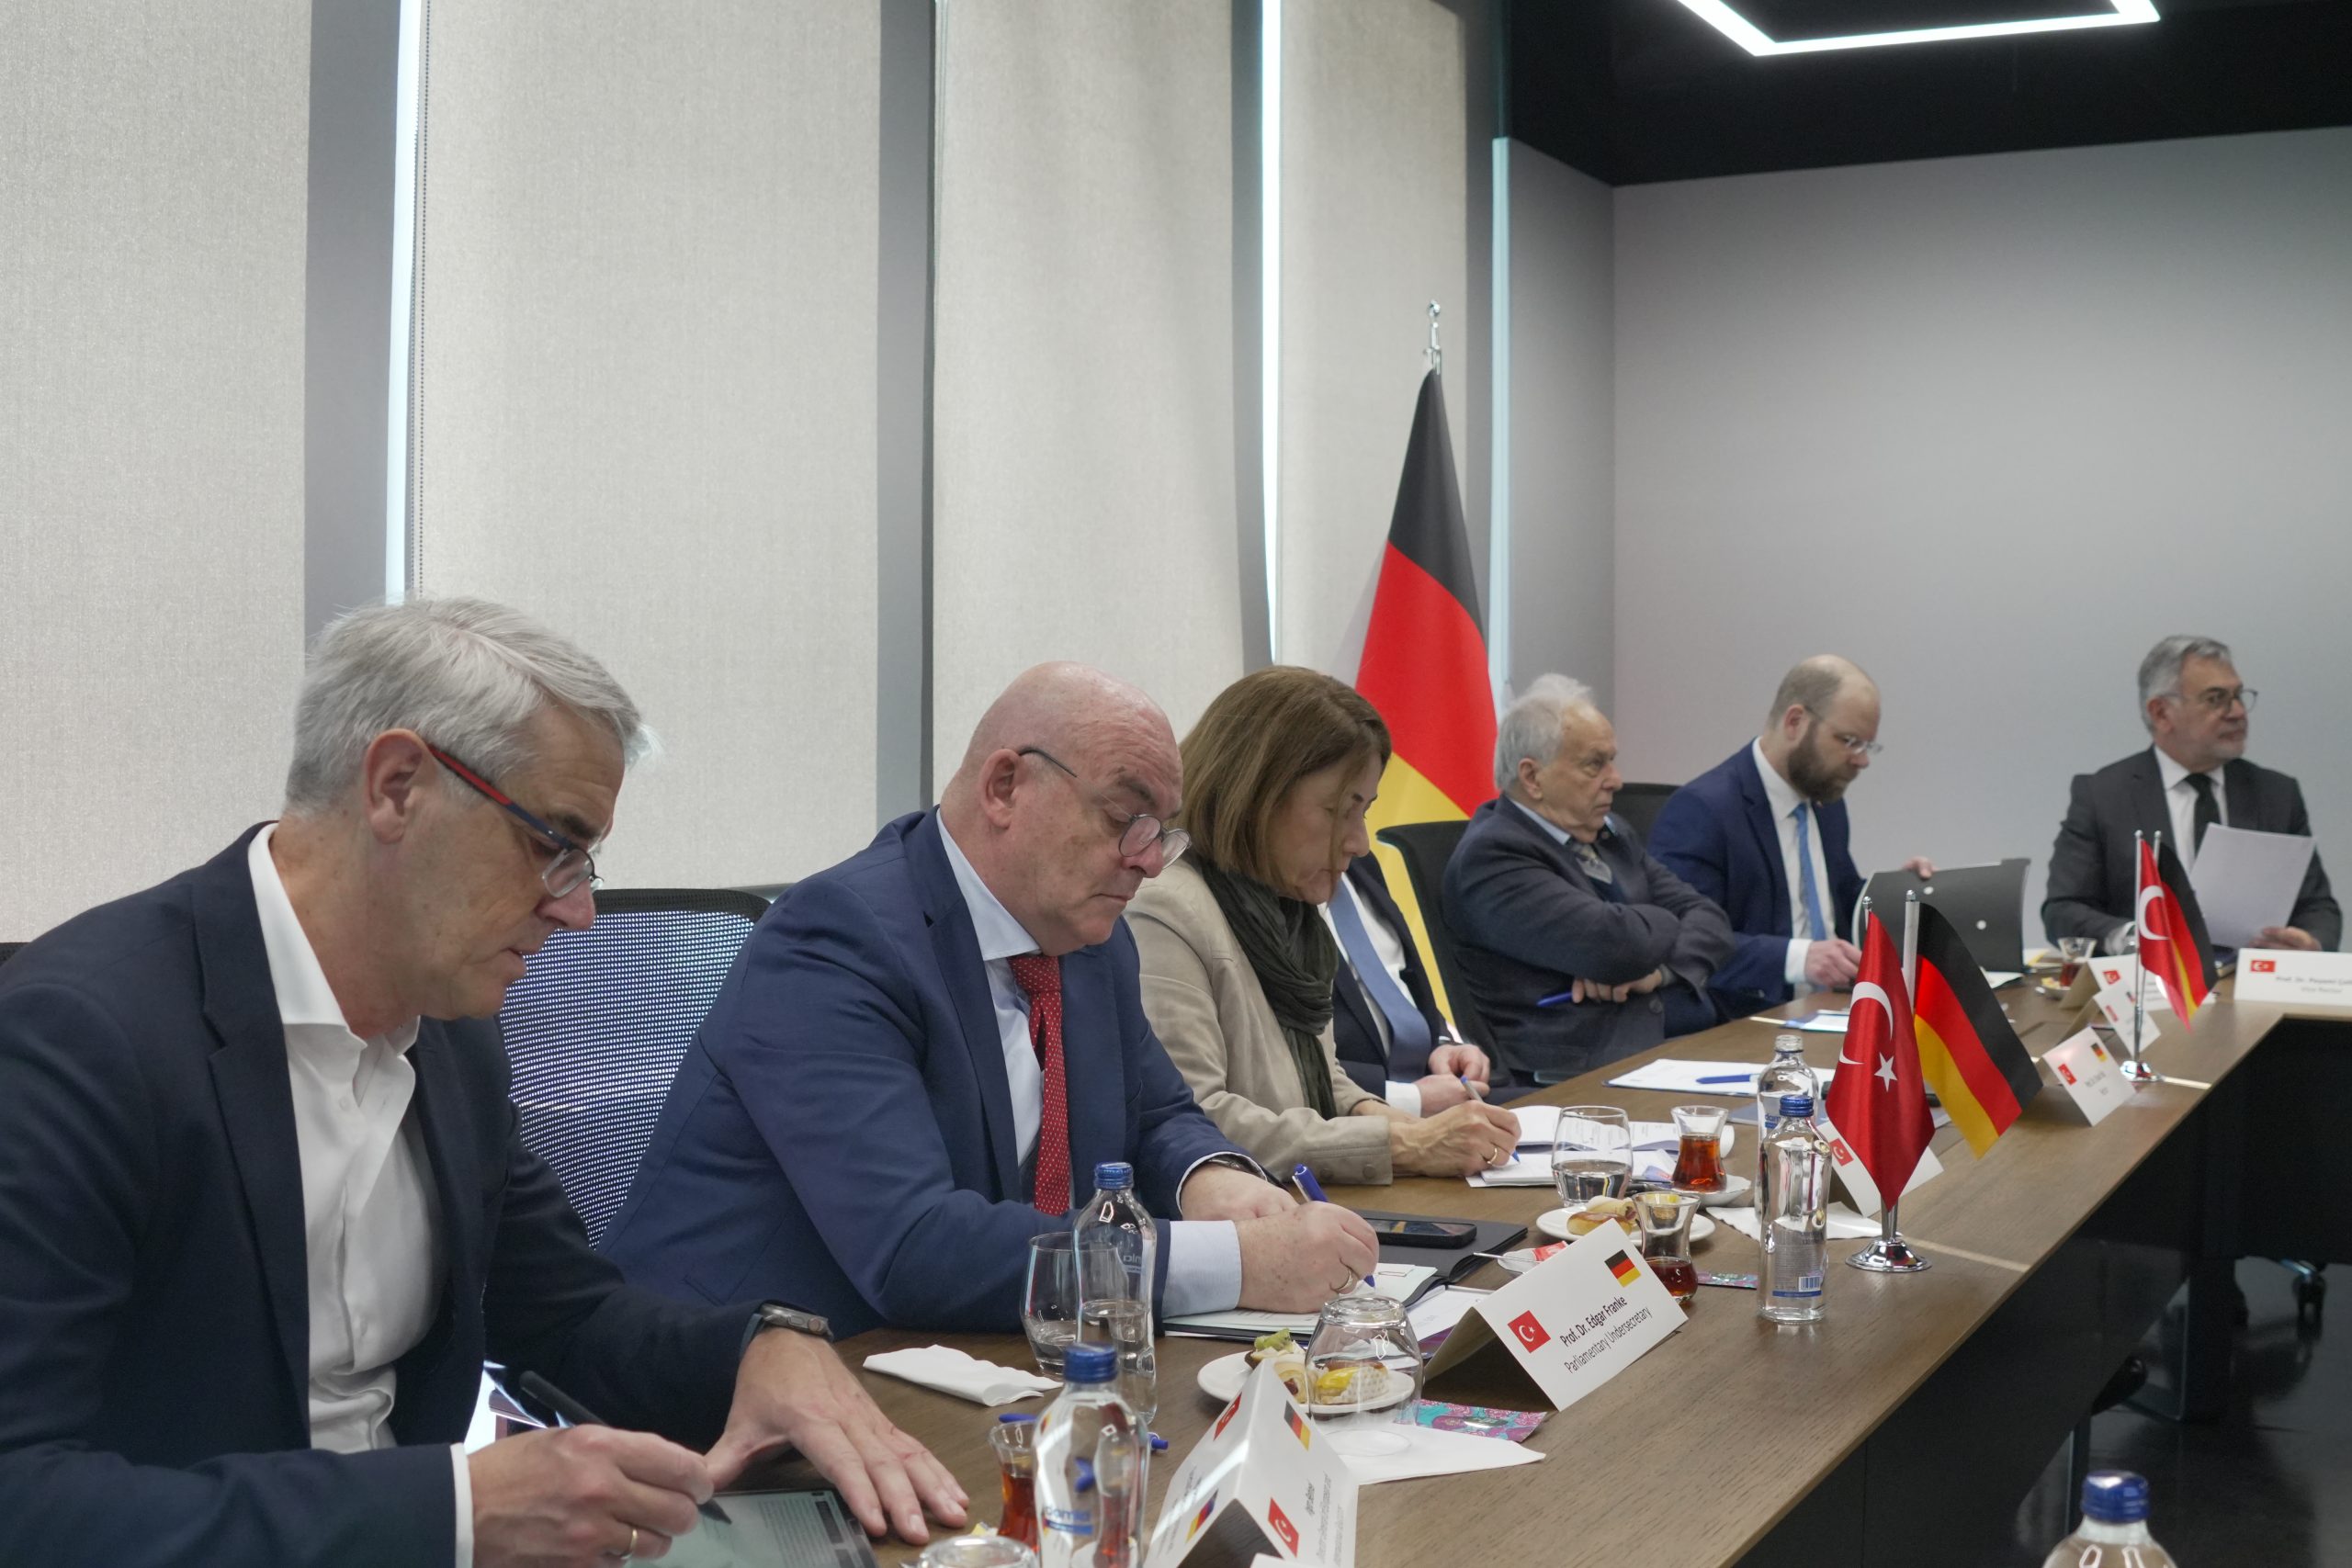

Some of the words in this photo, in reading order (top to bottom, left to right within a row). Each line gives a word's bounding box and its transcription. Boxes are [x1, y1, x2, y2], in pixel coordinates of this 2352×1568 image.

[1560, 1328, 1580, 1347] Prof.
[1576, 1324, 1590, 1336] Dr.
[1585, 1312, 1608, 1326] Edgar
[1602, 1296, 1627, 1317] Franke
[1564, 1337, 1611, 1373] Parliamentary
[1605, 1307, 1653, 1343] Undersecretary
